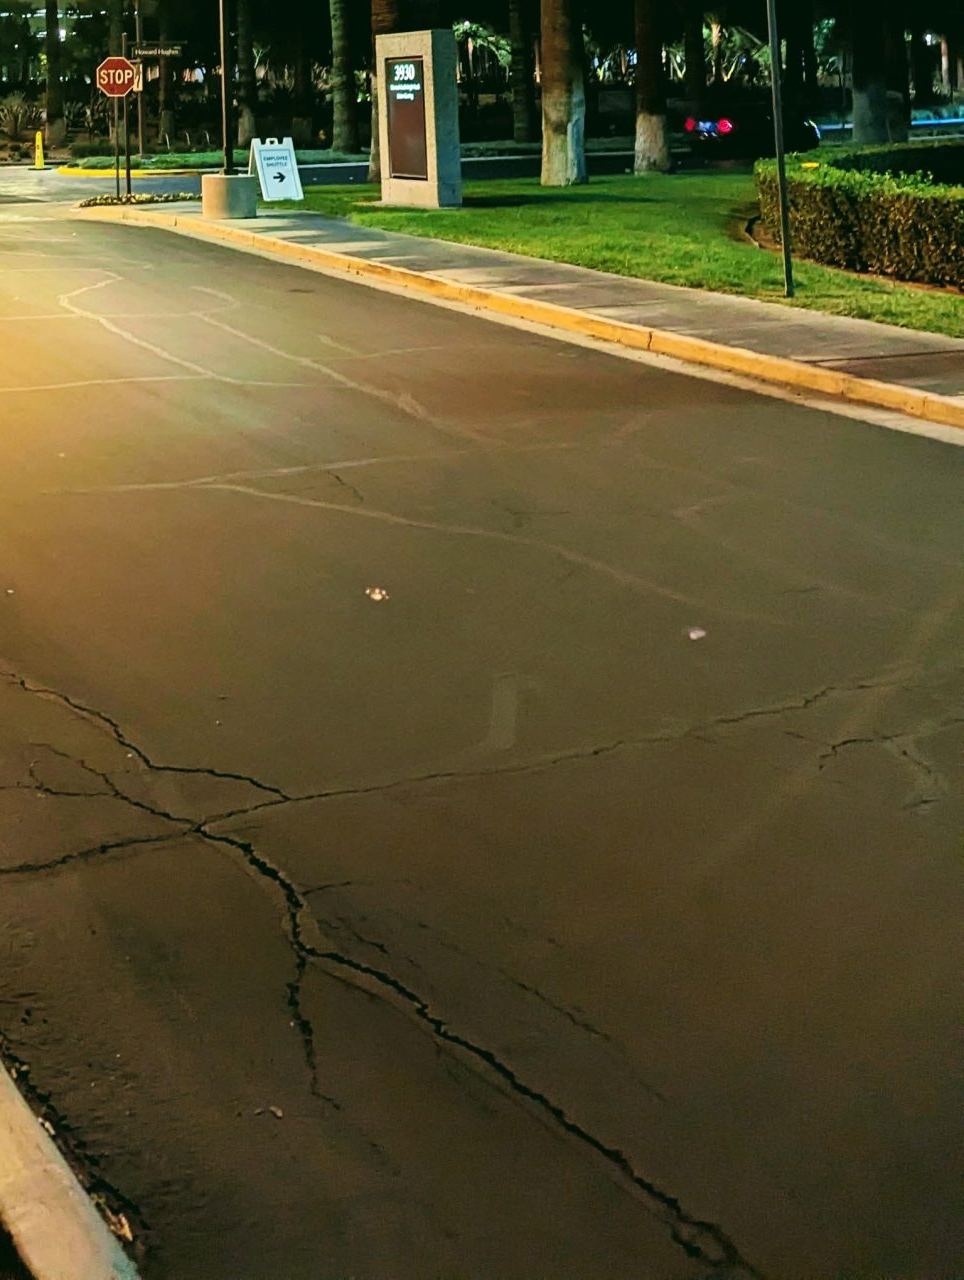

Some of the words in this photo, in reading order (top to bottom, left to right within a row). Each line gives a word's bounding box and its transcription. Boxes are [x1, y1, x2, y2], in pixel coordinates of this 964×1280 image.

[135, 48, 157, 56] Howard
[158, 48, 179, 57] Hughes
[100, 69, 133, 85] STOP
[394, 64, 415, 81] 3930
